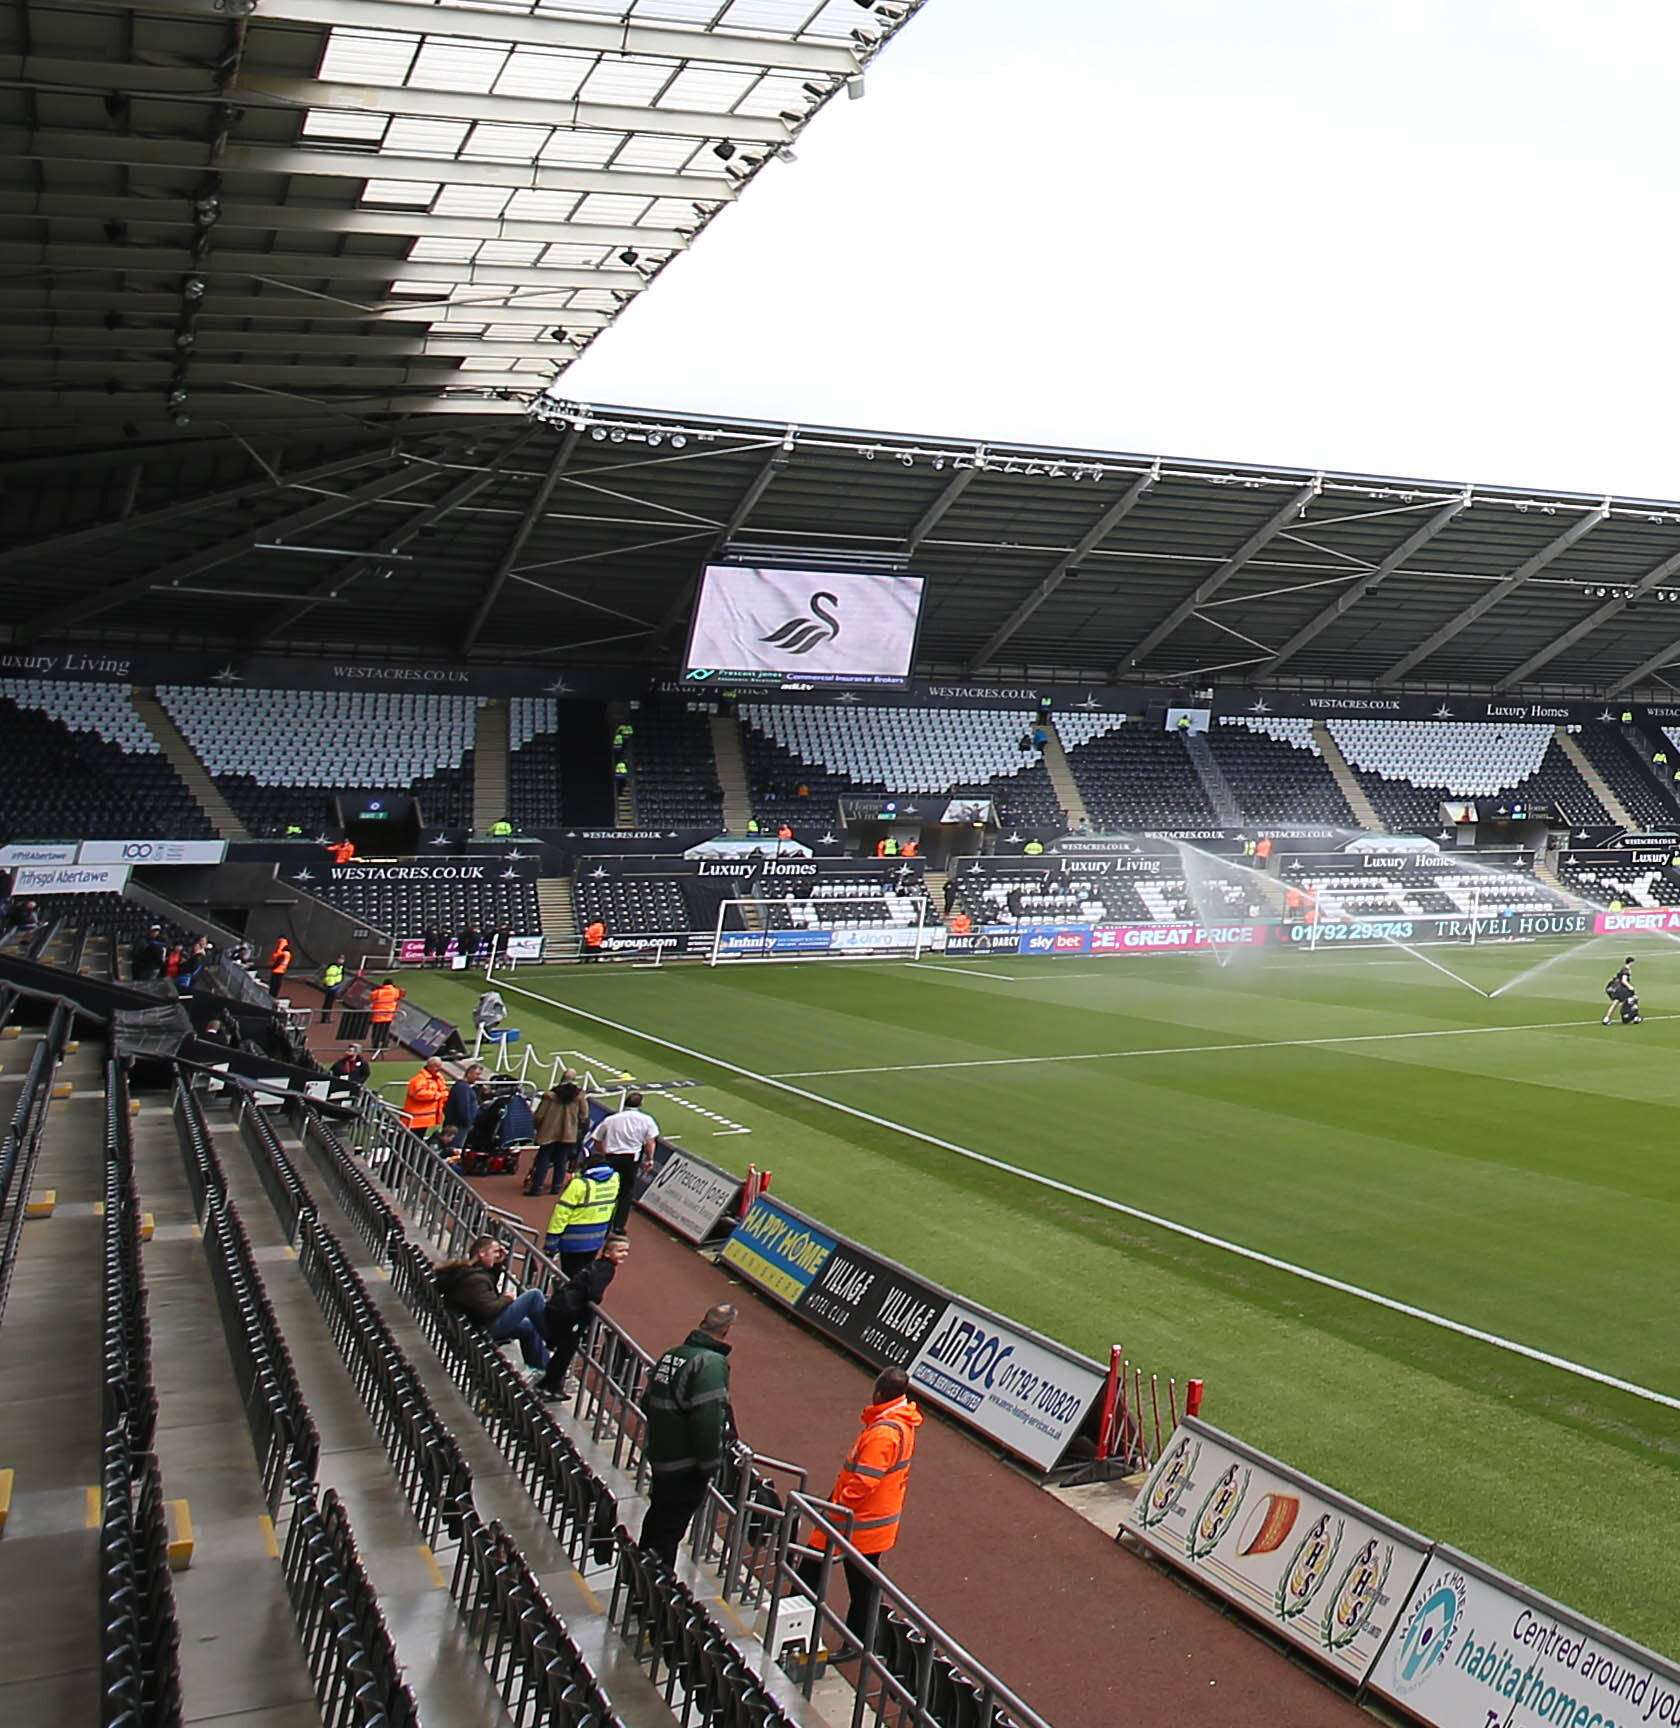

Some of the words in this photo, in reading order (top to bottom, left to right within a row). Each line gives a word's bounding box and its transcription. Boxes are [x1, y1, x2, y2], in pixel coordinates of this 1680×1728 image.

[2, 655, 56, 672] uxury
[65, 654, 130, 676] Living
[333, 666, 470, 682] WESTACRES.CO.UK
[786, 672, 834, 681] Commercial
[929, 687, 1038, 700] WESTACRES.CO.UK
[1309, 698, 1400, 710] WESTACRES.CO.UK
[1487, 703, 1528, 718] Luxury
[1531, 704, 1569, 718] Homes
[122, 843, 152, 858] 100
[698, 861, 757, 879] Luxury
[763, 861, 817, 876] Homes
[1060, 858, 1112, 874] Luxury
[1116, 857, 1161, 874] Living
[1363, 855, 1407, 870] Luxury
[1415, 855, 1456, 867] Homes
[56, 870, 108, 884] Abertawe
[330, 866, 484, 881] WESTACRES.CO.UK
[1291, 925, 1346, 942] 01792
[1349, 922, 1413, 941] 293743
[1435, 919, 1511, 937] TRAVEL
[1519, 916, 1586, 933] HOUSE
[600, 937, 677, 951] a1group.com
[948, 937, 974, 949] MARC
[992, 934, 1020, 947] DARCY
[1029, 934, 1053, 950] sky
[1057, 933, 1081, 947] bet
[1124, 928, 1193, 947] GREAT
[1196, 927, 1252, 945] PRICE
[702, 1181, 730, 1208] Jones
[739, 1206, 787, 1249] HAPPY
[776, 1231, 831, 1275] HOME
[821, 1256, 875, 1306] VILLAGE
[877, 1286, 936, 1342] VILLAGE
[807, 1292, 828, 1314] HOTEL
[828, 1305, 851, 1327] CLUB
[860, 1326, 883, 1351] HOTEL
[884, 1341, 910, 1365] CLUB
[935, 1373, 961, 1399] SERVICES
[959, 1387, 981, 1412] LIMITED
[998, 1362, 1034, 1403] 01792
[1031, 1378, 1083, 1425] 700820
[1399, 1571, 1452, 1640] HABITAT
[1512, 1608, 1588, 1669] Centred
[1580, 1649, 1653, 1707] around
